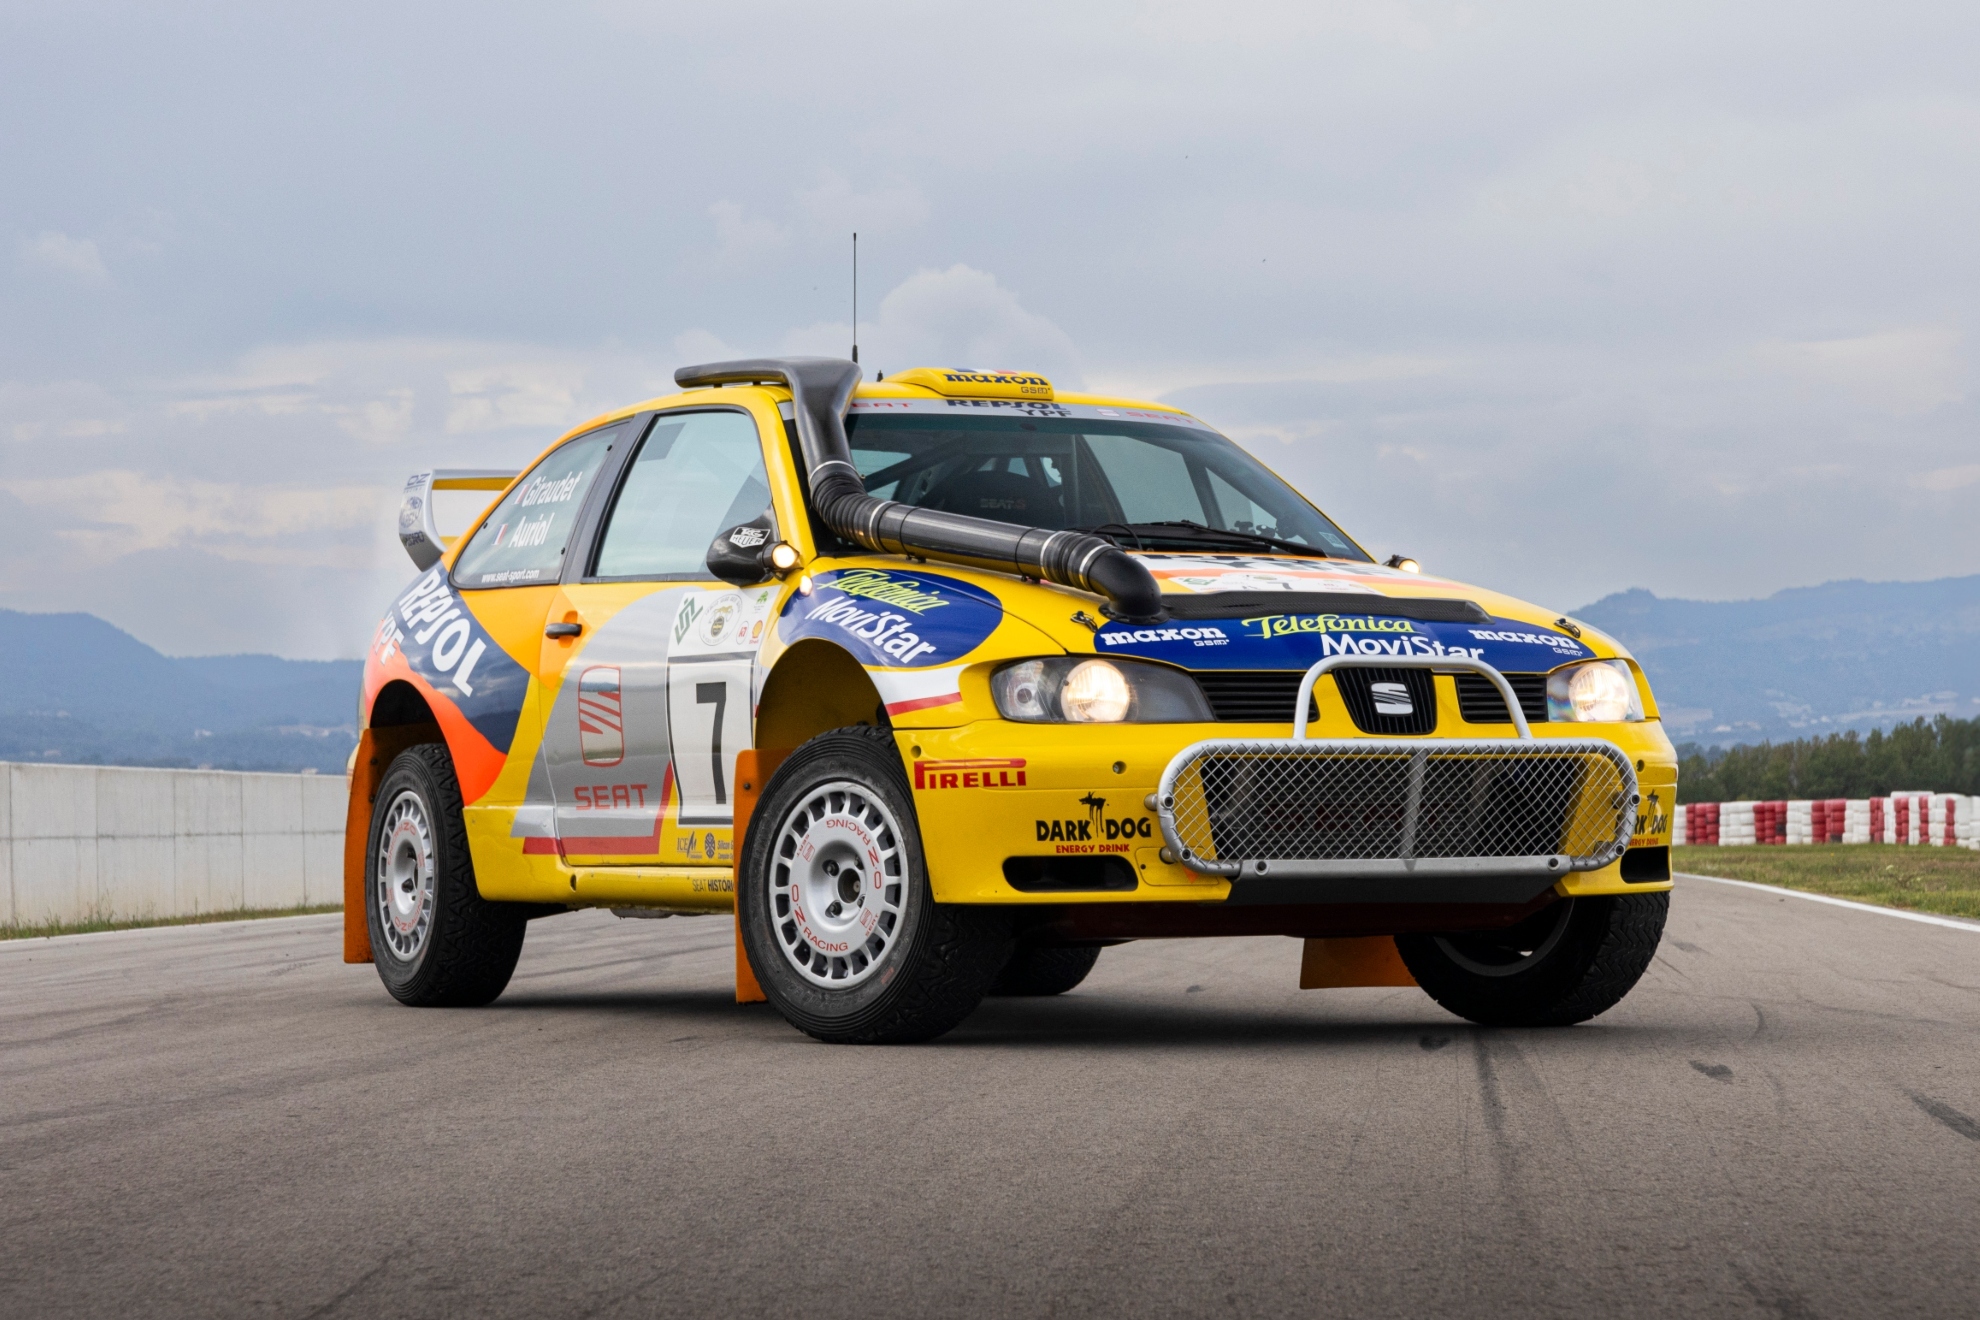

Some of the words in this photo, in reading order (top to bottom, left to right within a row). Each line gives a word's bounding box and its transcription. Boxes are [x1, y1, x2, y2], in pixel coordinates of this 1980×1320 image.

[943, 373, 1049, 386] maxon
[946, 399, 1067, 410] REPSOL
[1126, 411, 1193, 424] SEAT
[1016, 408, 1072, 417] YPF
[522, 471, 582, 506] Giraudet
[509, 512, 555, 548] Auriol
[732, 536, 762, 546] HEUER
[481, 568, 540, 583] www.seat-sport.com
[373, 611, 405, 665] YPF
[399, 569, 487, 697] REPSOL
[805, 596, 936, 664] MoviStar
[1100, 627, 1227, 646] maxon
[1468, 629, 1580, 650] maxon
[1321, 633, 1484, 657] MoviStar
[696, 681, 727, 805] 7
[914, 758, 1027, 790] PIRELLI
[574, 784, 649, 811] SEAT
[825, 818, 872, 846] RACING
[1035, 819, 1093, 842] DARK
[1105, 817, 1152, 840] DOG
[1651, 813, 1669, 835] DOG
[1055, 844, 1095, 853] ENERGY
[1098, 843, 1130, 853] DRINK
[1629, 838, 1646, 847] NERGY
[692, 878, 707, 892] SEAT
[803, 926, 849, 952] RACING
